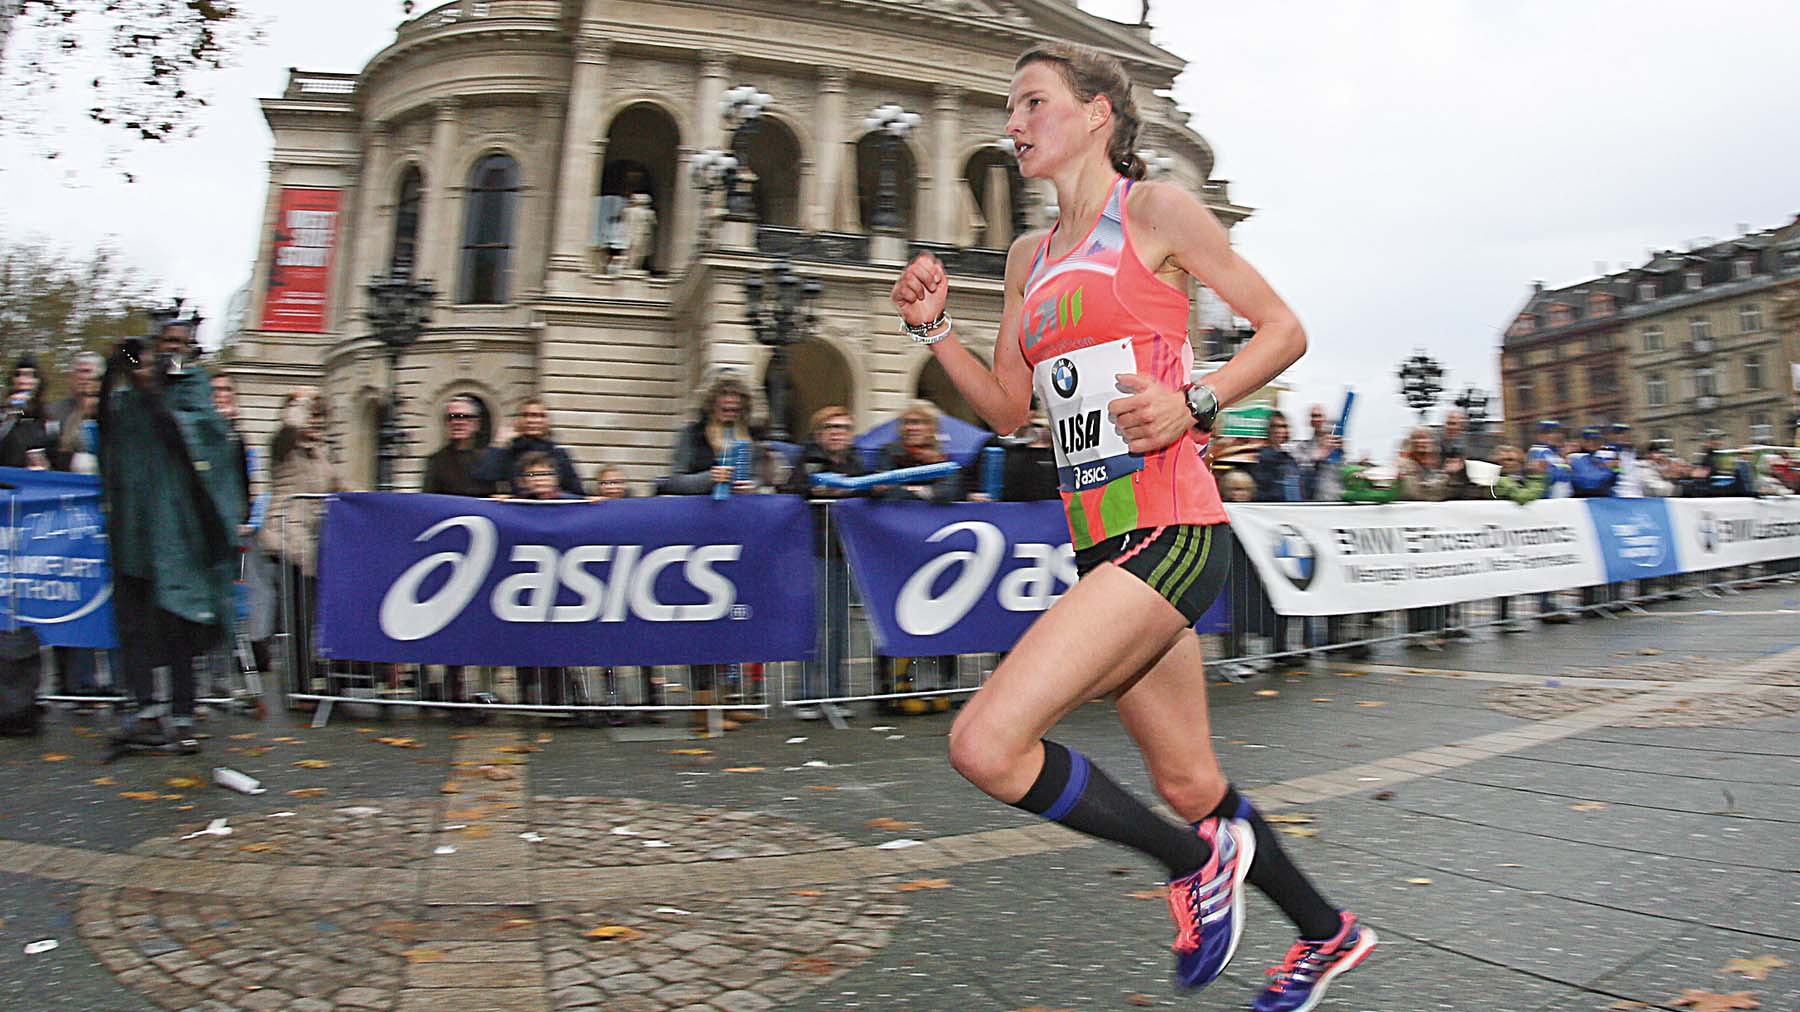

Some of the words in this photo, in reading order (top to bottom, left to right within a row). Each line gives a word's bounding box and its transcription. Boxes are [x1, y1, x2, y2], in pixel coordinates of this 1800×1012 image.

[1059, 410, 1101, 454] LISA
[1081, 465, 1107, 485] asics
[490, 545, 743, 622] asics
